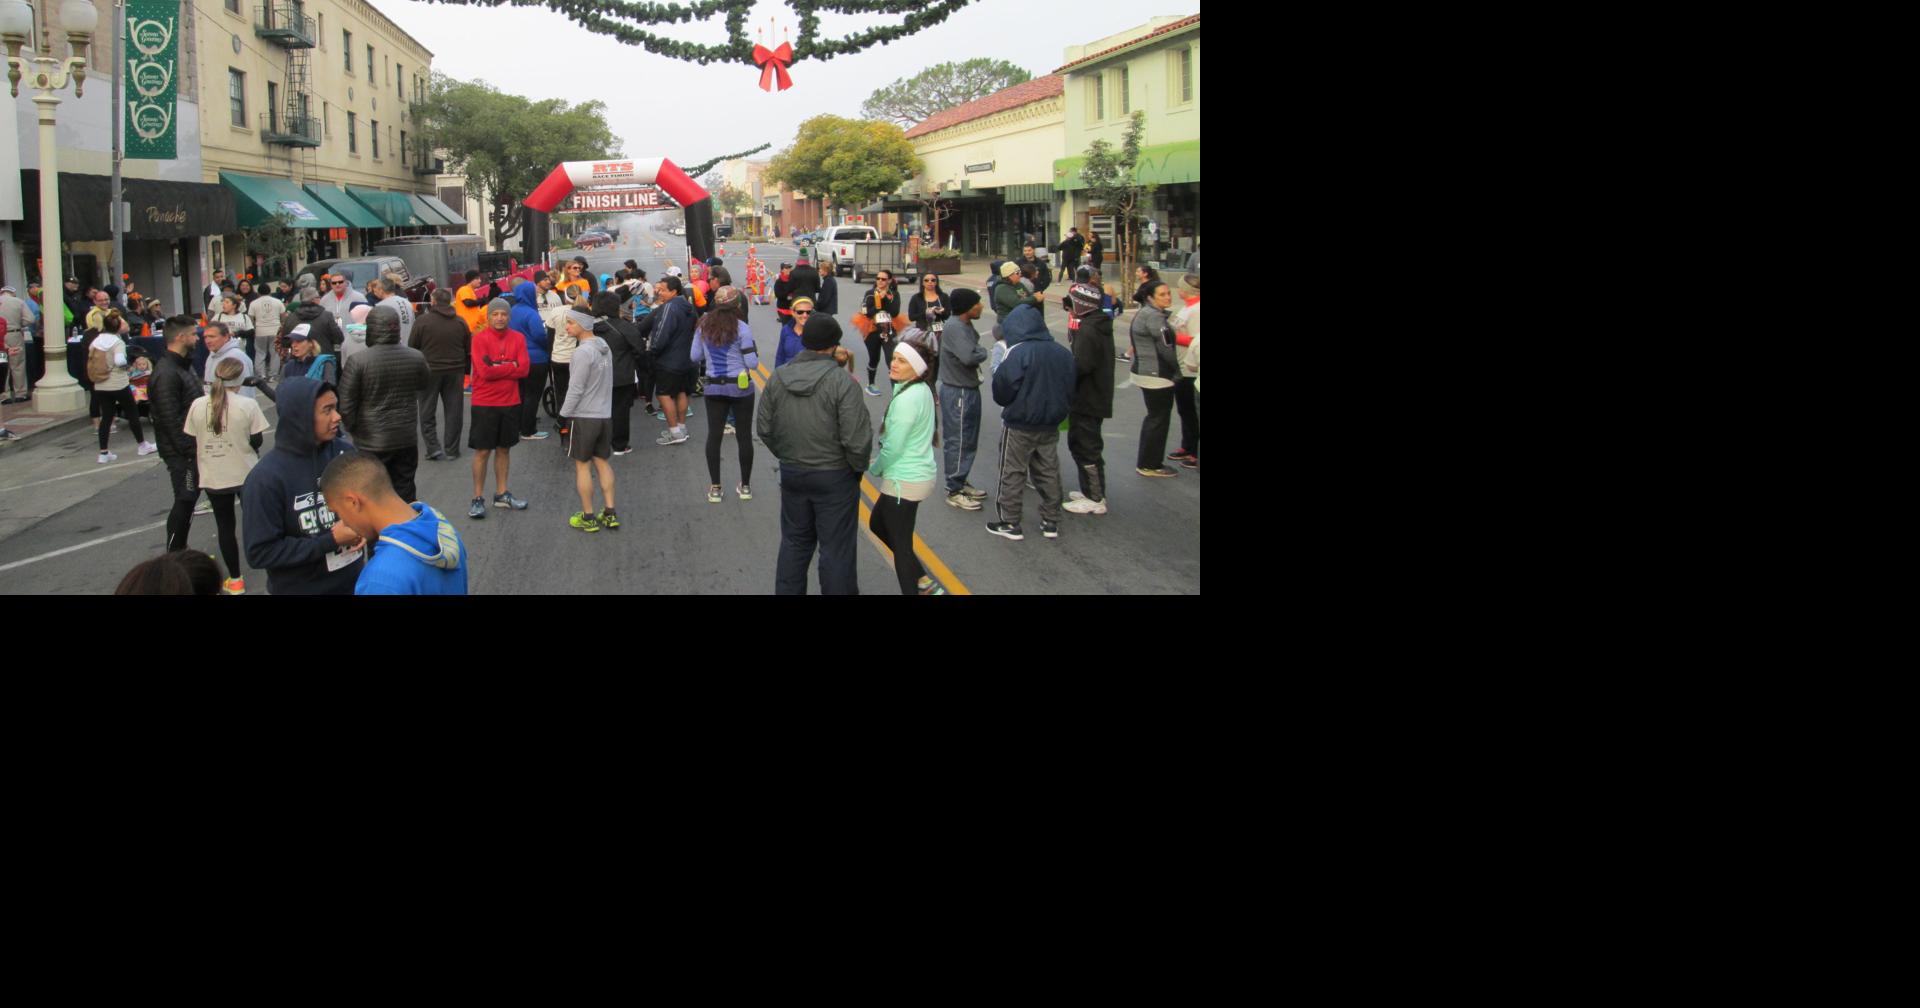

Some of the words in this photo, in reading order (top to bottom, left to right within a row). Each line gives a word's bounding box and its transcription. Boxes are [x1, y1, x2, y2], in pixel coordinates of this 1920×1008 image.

[593, 163, 634, 172] RTS
[574, 194, 620, 208] FINISH
[625, 193, 658, 206] LINE
[145, 204, 187, 223] Panache
